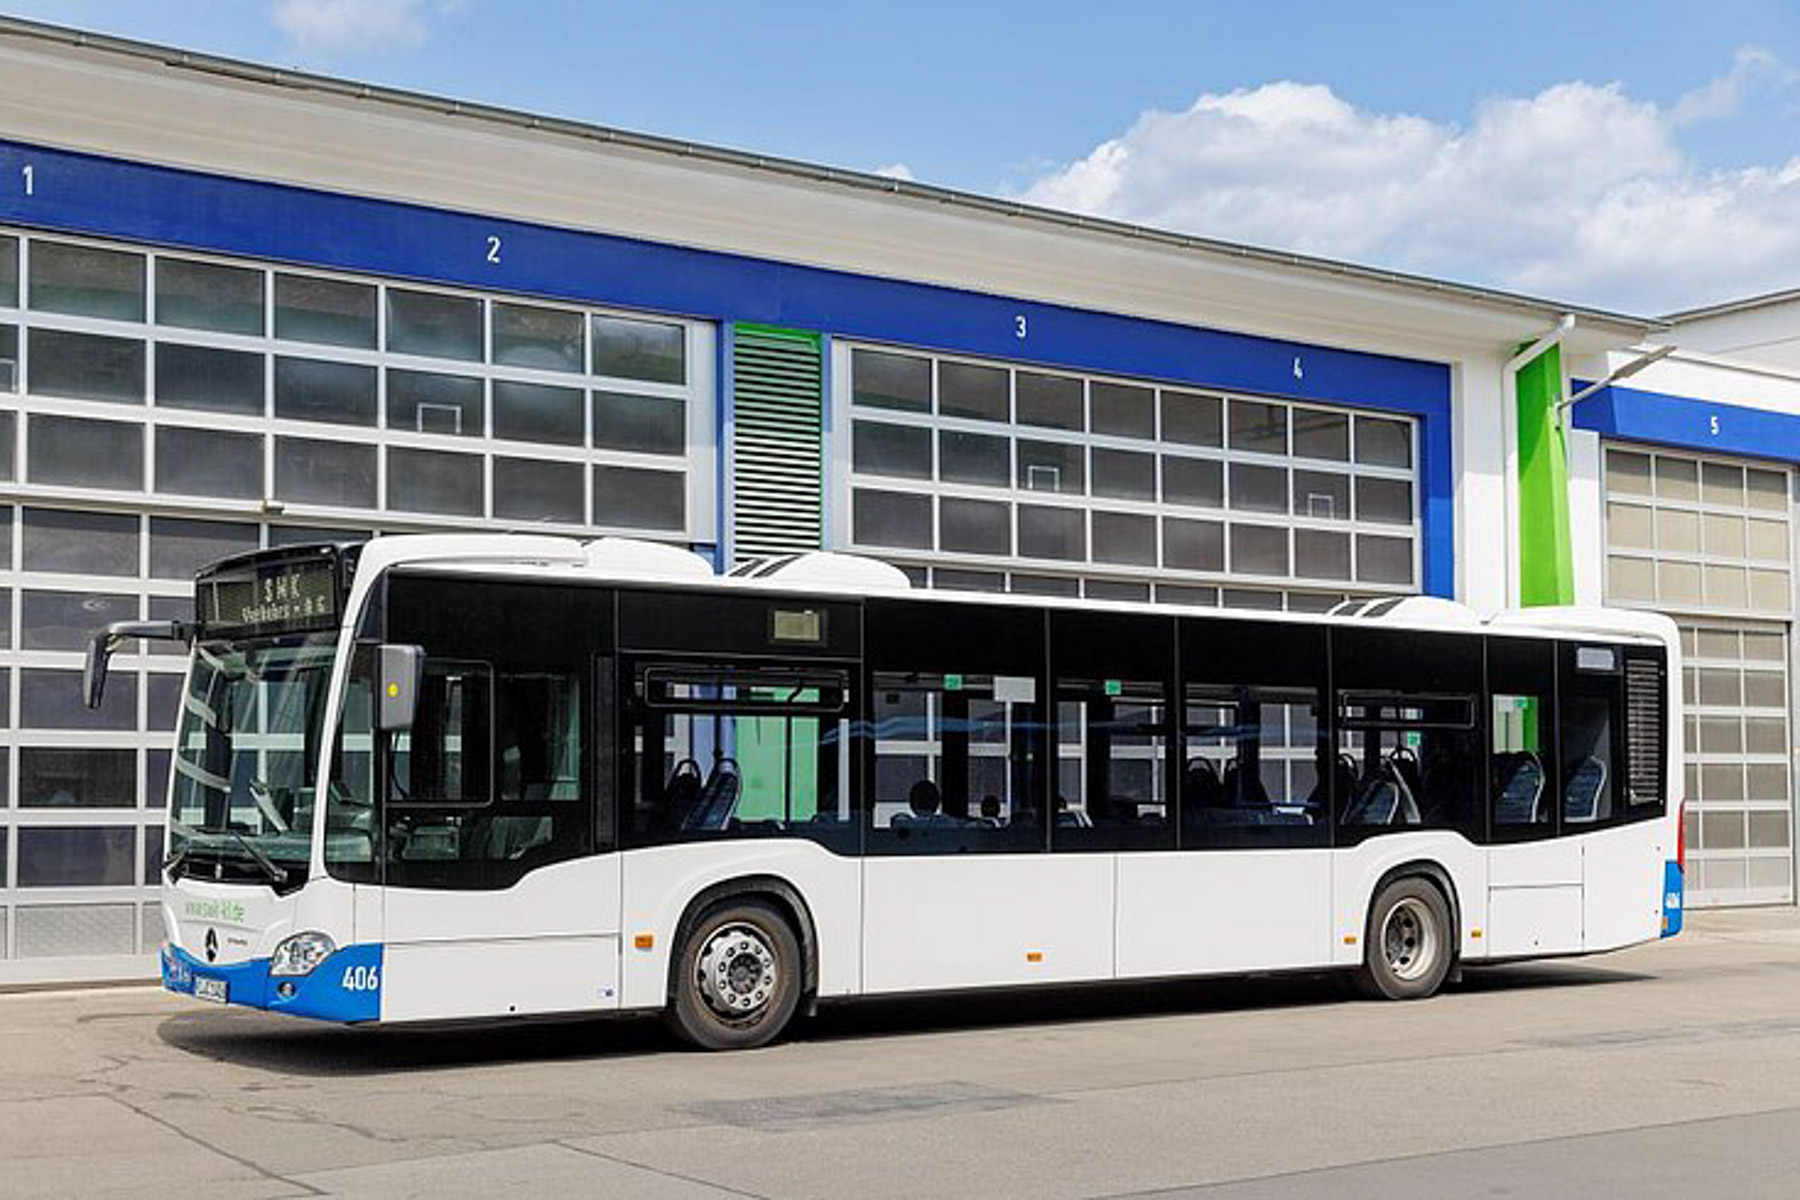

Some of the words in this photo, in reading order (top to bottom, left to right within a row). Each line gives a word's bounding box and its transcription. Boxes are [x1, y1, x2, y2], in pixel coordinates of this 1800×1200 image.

[23, 165, 33, 195] 1
[487, 236, 501, 263] 2
[1015, 315, 1026, 338] 3
[1294, 357, 1303, 379] 4
[1710, 415, 1719, 435] 5
[342, 965, 379, 991] 406
